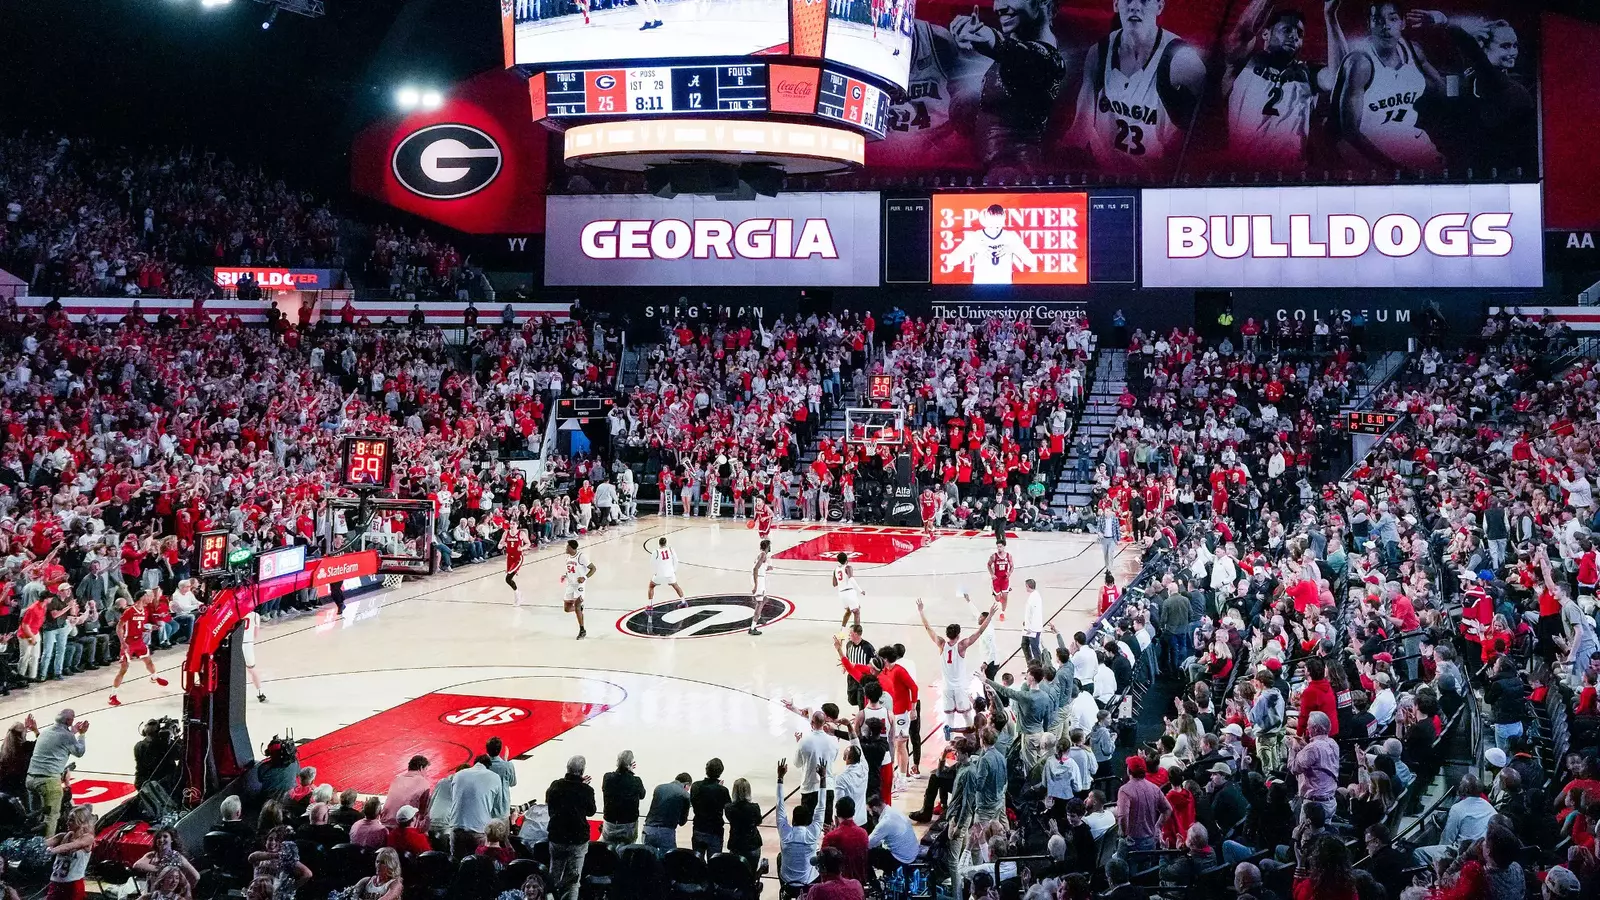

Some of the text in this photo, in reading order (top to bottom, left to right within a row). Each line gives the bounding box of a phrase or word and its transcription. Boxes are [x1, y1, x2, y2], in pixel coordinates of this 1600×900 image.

[556, 73, 576, 82] FOULS
[640, 70, 656, 78] POSS
[728, 67, 752, 76] FOULS
[562, 82, 568, 91] 3
[654, 80, 664, 90] 29
[737, 77, 743, 86] 6
[598, 96, 614, 111] 25
[635, 96, 664, 111] 8:11
[688, 92, 702, 108] 12
[747, 100, 754, 109] 3
[1262, 87, 1284, 117] 2
[1368, 91, 1418, 112] GEORGI
[571, 105, 576, 114] 4
[1114, 118, 1146, 156] 23
[580, 218, 839, 260] GEORGIA
[940, 230, 1078, 250] 3-TER
[1166, 212, 1514, 259] BULLDOGS
[1566, 232, 1595, 249] AA
[507, 237, 528, 252] YY
[932, 305, 1087, 322] The University of Georgia
[872, 384, 888, 397] 29
[1367, 414, 1383, 424] 8:10
[356, 441, 385, 456] 8:10
[351, 457, 379, 481] 29
[895, 486, 911, 495] Alfa
[203, 551, 219, 568] 29
[661, 550, 670, 560] 11
[567, 565, 576, 574] 54
[837, 570, 844, 581] 3
[946, 649, 953, 664] 1
